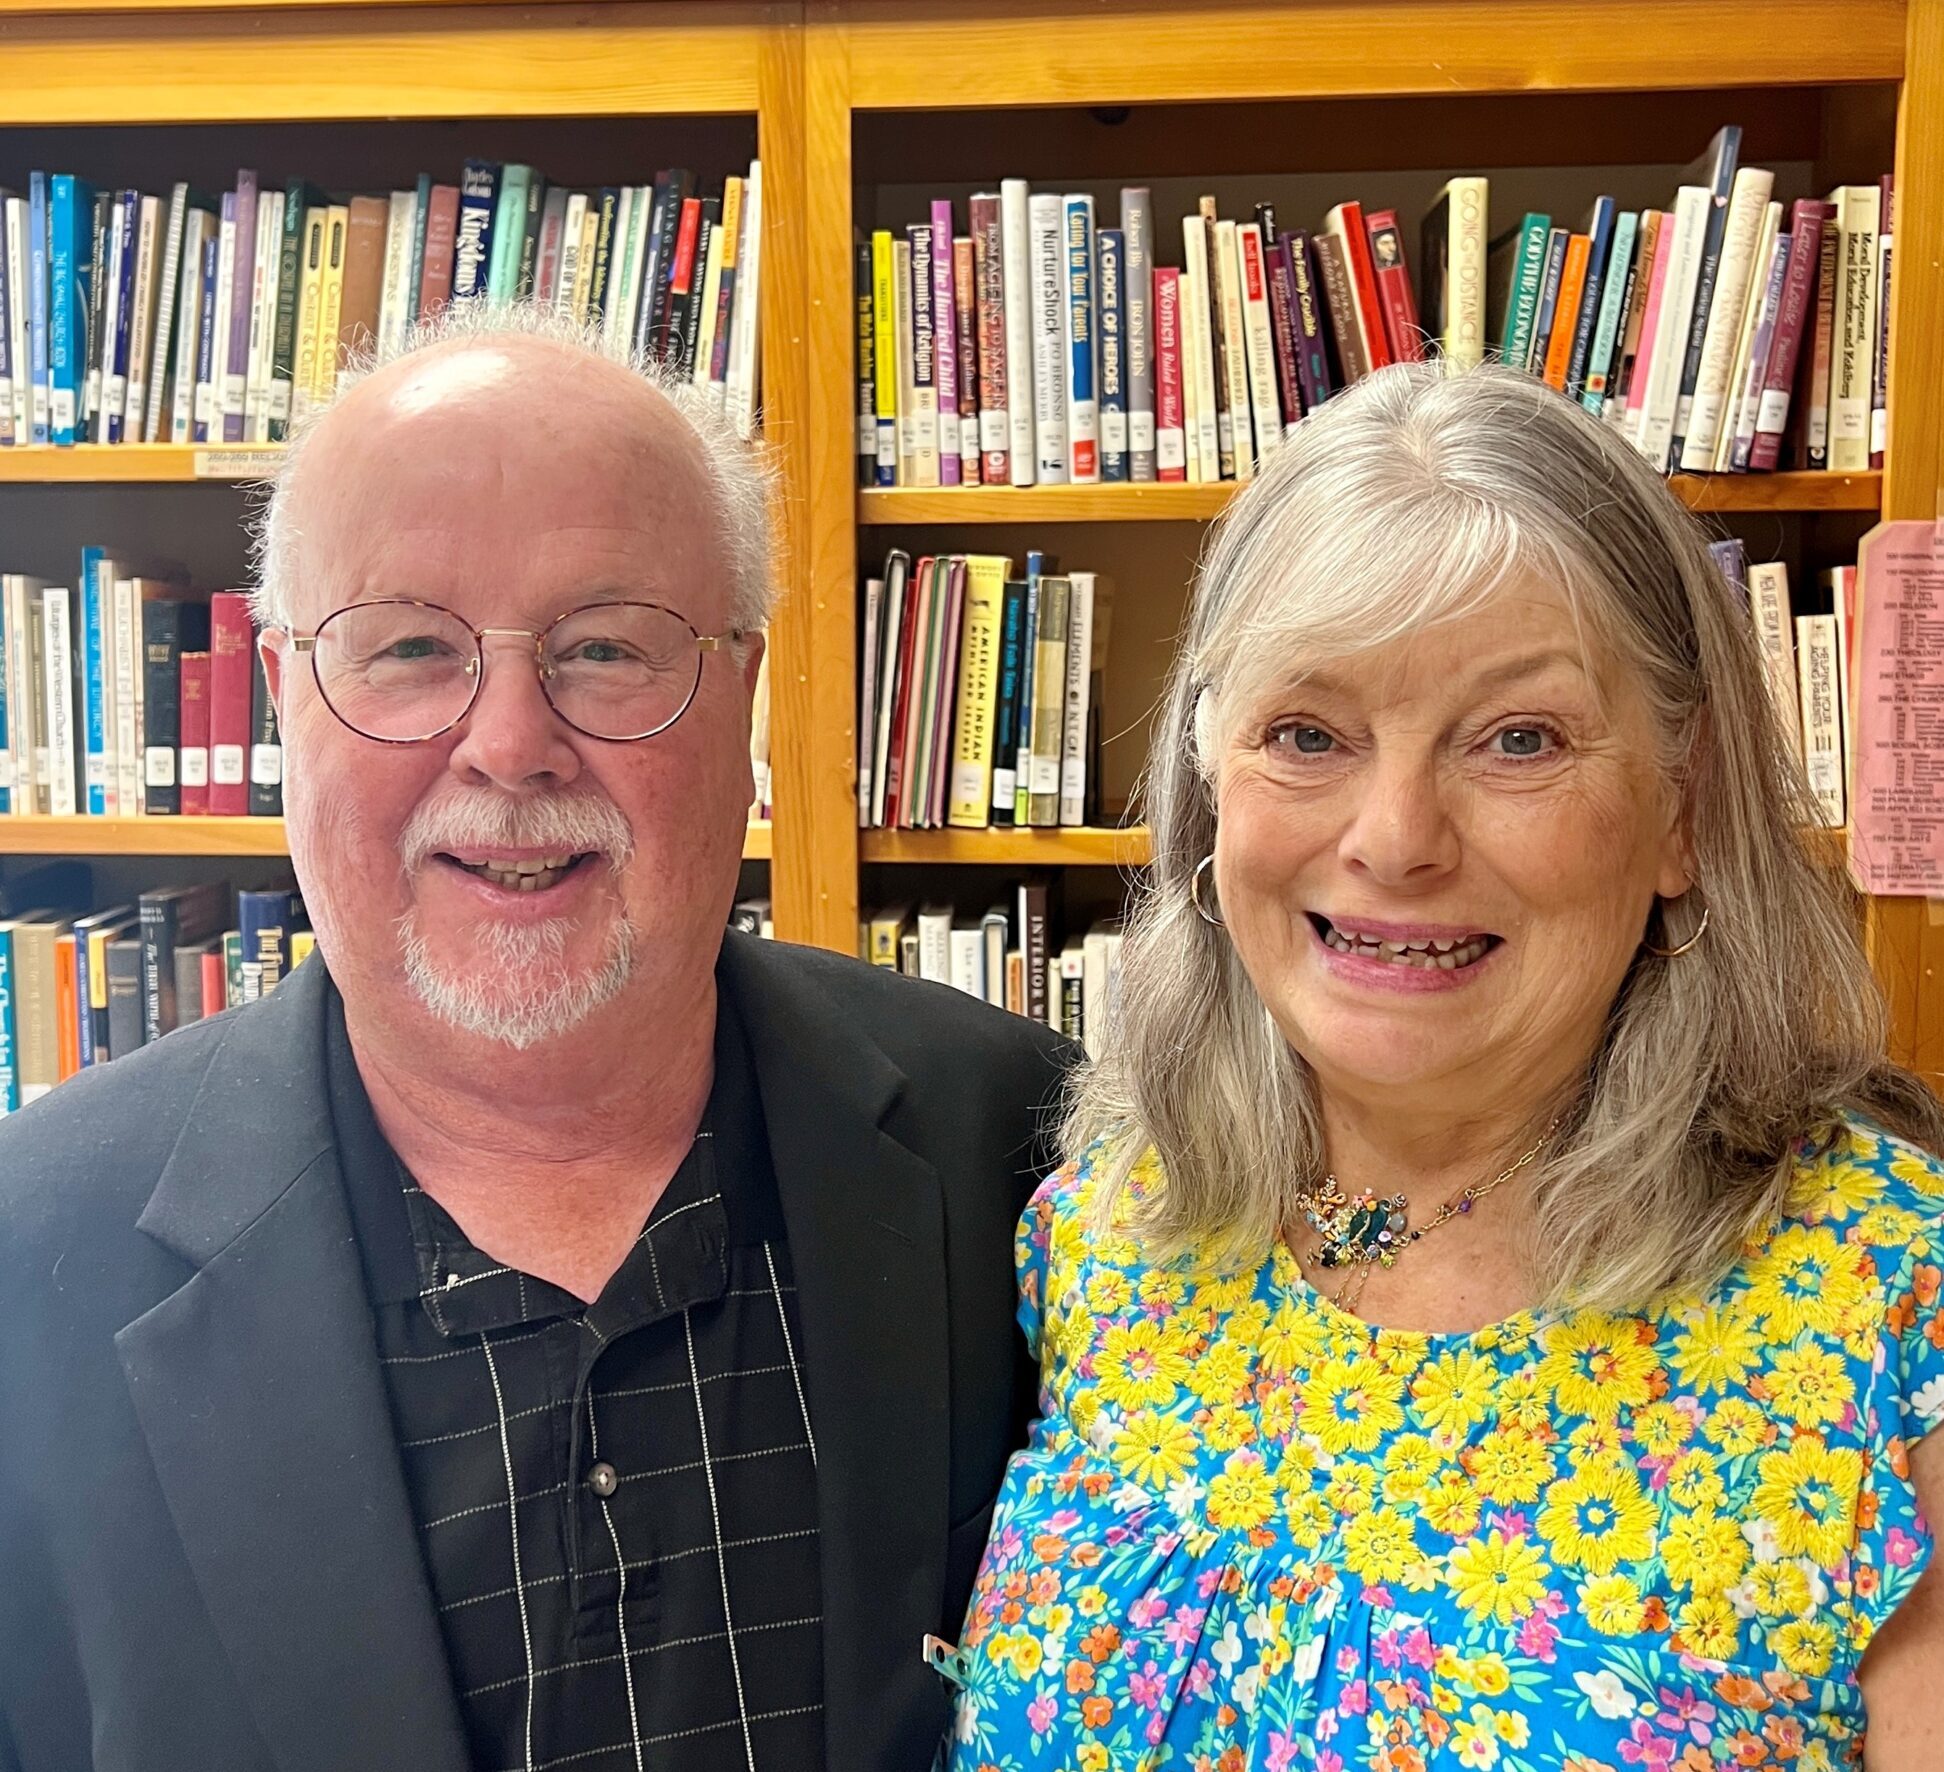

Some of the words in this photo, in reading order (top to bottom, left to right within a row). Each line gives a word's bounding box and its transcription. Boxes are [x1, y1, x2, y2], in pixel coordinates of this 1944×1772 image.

[1068, 212, 1089, 248] Caring
[1128, 209, 1143, 248] Robert
[1461, 187, 1480, 250] GOING
[455, 206, 490, 294] Kingdoms
[565, 245, 579, 269] GOD
[913, 229, 932, 253] The
[986, 222, 1000, 257] FROM
[1102, 237, 1114, 250] A
[1246, 239, 1258, 260] bell
[1290, 237, 1304, 260] The
[1526, 225, 1546, 262] GOD
[1796, 223, 1817, 262] Letter
[1846, 231, 1859, 266] Moral
[1859, 231, 1873, 266] Moral
[933, 258, 949, 287] The
[1072, 251, 1088, 268] for
[1126, 250, 1143, 271] Bly
[1294, 259, 1310, 295] Family
[1704, 256, 1717, 277] The
[1793, 264, 1805, 280] to
[563, 271, 577, 285] OF
[912, 253, 932, 312] Dynamics
[987, 258, 1003, 326] AGE-ING
[1042, 229, 1060, 337] NurtureShock
[1072, 271, 1088, 295] Your
[1102, 252, 1118, 310] CHOICE
[1520, 261, 1540, 295] THE
[719, 288, 730, 307] The
[859, 295, 872, 313] The
[1159, 278, 1177, 348] Women
[1335, 270, 1352, 323] NATURAL
[1459, 266, 1479, 345] DISTANCE
[1784, 281, 1805, 328] Louise
[916, 314, 932, 331] of
[934, 289, 952, 349] Hurried
[1072, 299, 1089, 342] Parents
[1104, 315, 1118, 334] OF
[1131, 299, 1144, 335] IRON
[1299, 294, 1318, 338] Crucible
[1332, 312, 1348, 343] LOVE
[1579, 316, 1592, 339] FOR
[304, 334, 315, 345] &
[324, 333, 335, 344] &
[992, 329, 1004, 344] TO
[1050, 342, 1061, 360] PO
[1252, 326, 1271, 378] killing
[915, 333, 934, 382] Religion
[938, 349, 955, 398] Child
[963, 349, 976, 402] Childhood
[1104, 336, 1120, 394] HEROES
[1131, 337, 1146, 378] JOHN
[1162, 351, 1176, 385] Ruled
[990, 347, 1007, 411] SAGE-IN
[1052, 364, 1064, 422] BRONSO
[977, 626, 991, 702] AMERICAN
[1006, 643, 1018, 668] Folk
[1071, 621, 1084, 685] ELEMENTS
[1810, 645, 1821, 680] AGING
[1819, 645, 1831, 694] HELPING
[966, 672, 975, 698] AND
[1003, 670, 1018, 699] Tales
[1811, 681, 1823, 729] PARENTS
[1821, 696, 1832, 726] YOUR
[973, 707, 985, 762] INDIAN
[1031, 915, 1045, 1000] INTERIOR
